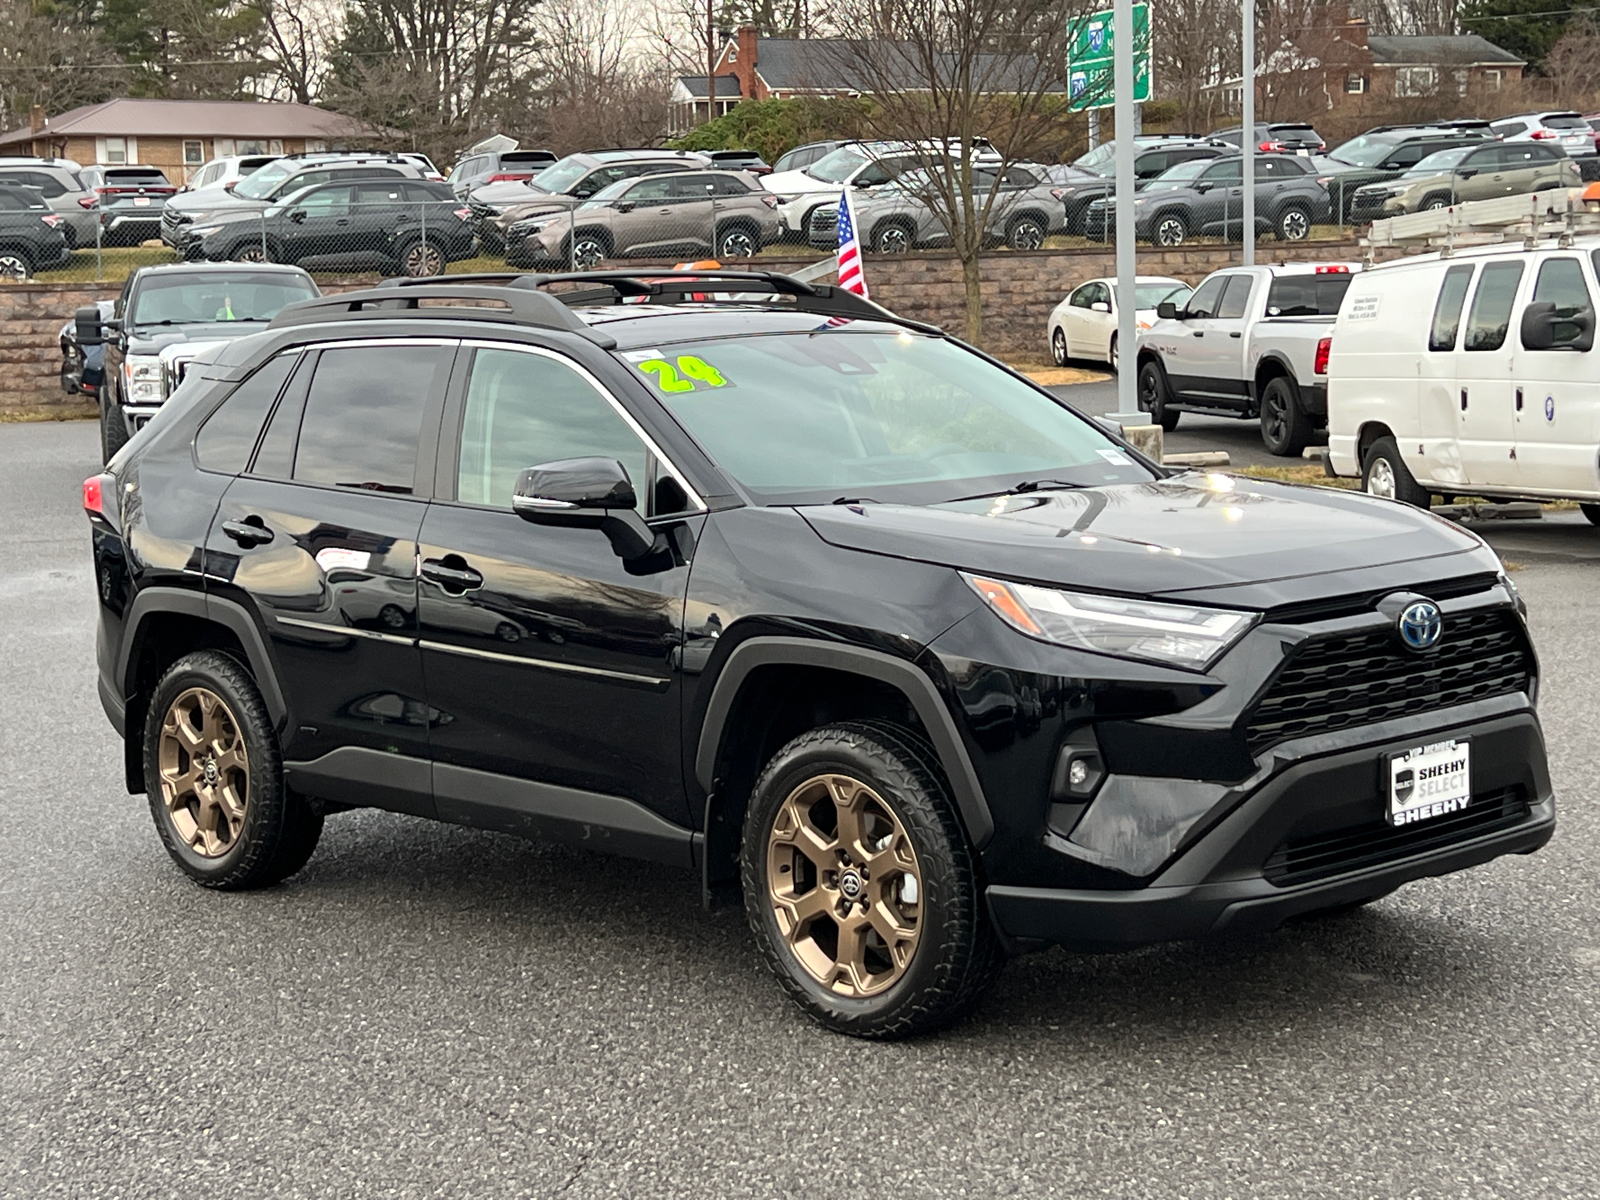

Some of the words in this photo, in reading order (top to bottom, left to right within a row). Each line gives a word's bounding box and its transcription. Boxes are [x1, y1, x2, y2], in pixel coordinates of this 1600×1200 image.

[1090, 31, 1102, 46] 70
[638, 355, 728, 393] 24
[1419, 758, 1466, 780] SHEEHY
[1419, 773, 1466, 798] SELECT
[1393, 795, 1470, 827] SHEEHY
